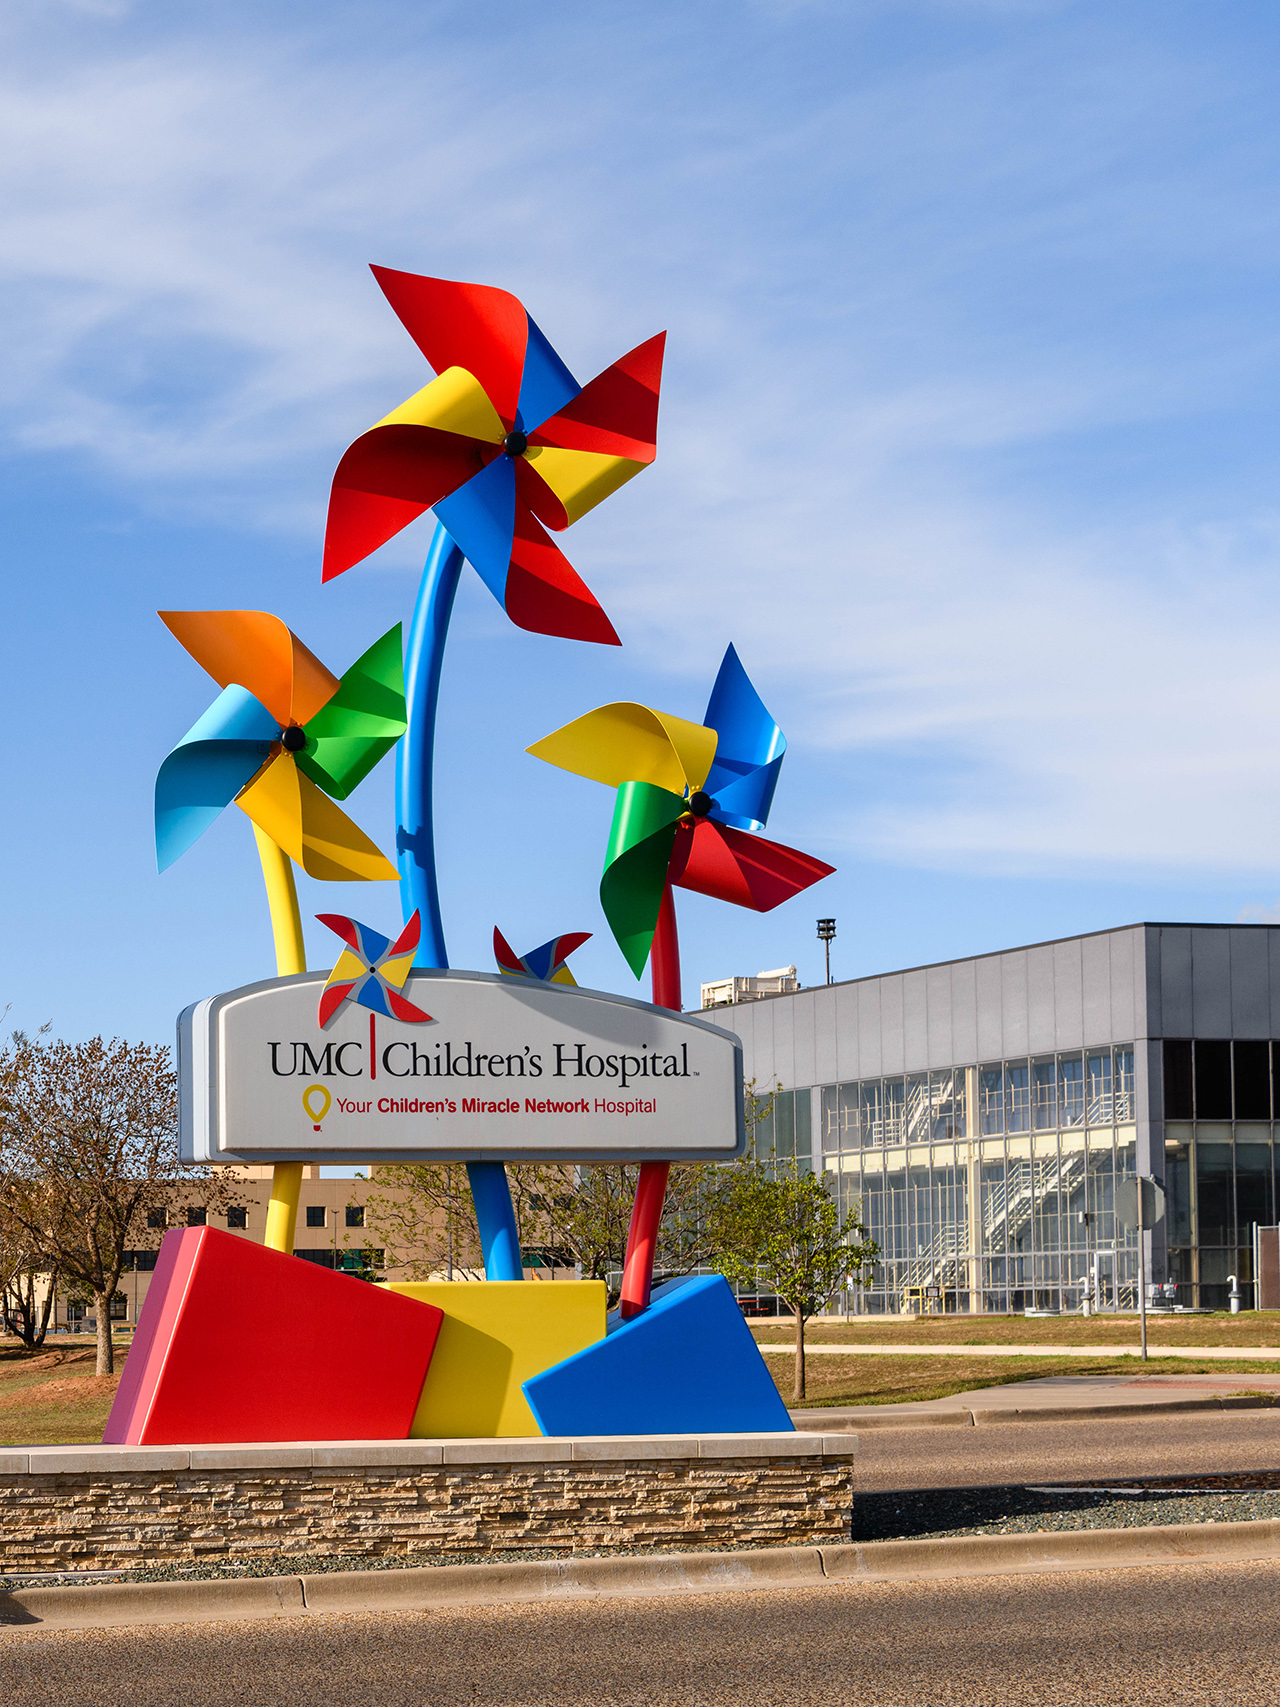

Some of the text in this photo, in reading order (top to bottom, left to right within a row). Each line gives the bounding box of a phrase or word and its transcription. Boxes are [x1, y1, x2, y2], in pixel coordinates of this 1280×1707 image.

[267, 1042, 363, 1077] UMC
[382, 1042, 543, 1077] Children’s
[552, 1043, 691, 1088] Hospital
[336, 1097, 657, 1117] Your Children’s Miracle Network Hospital
